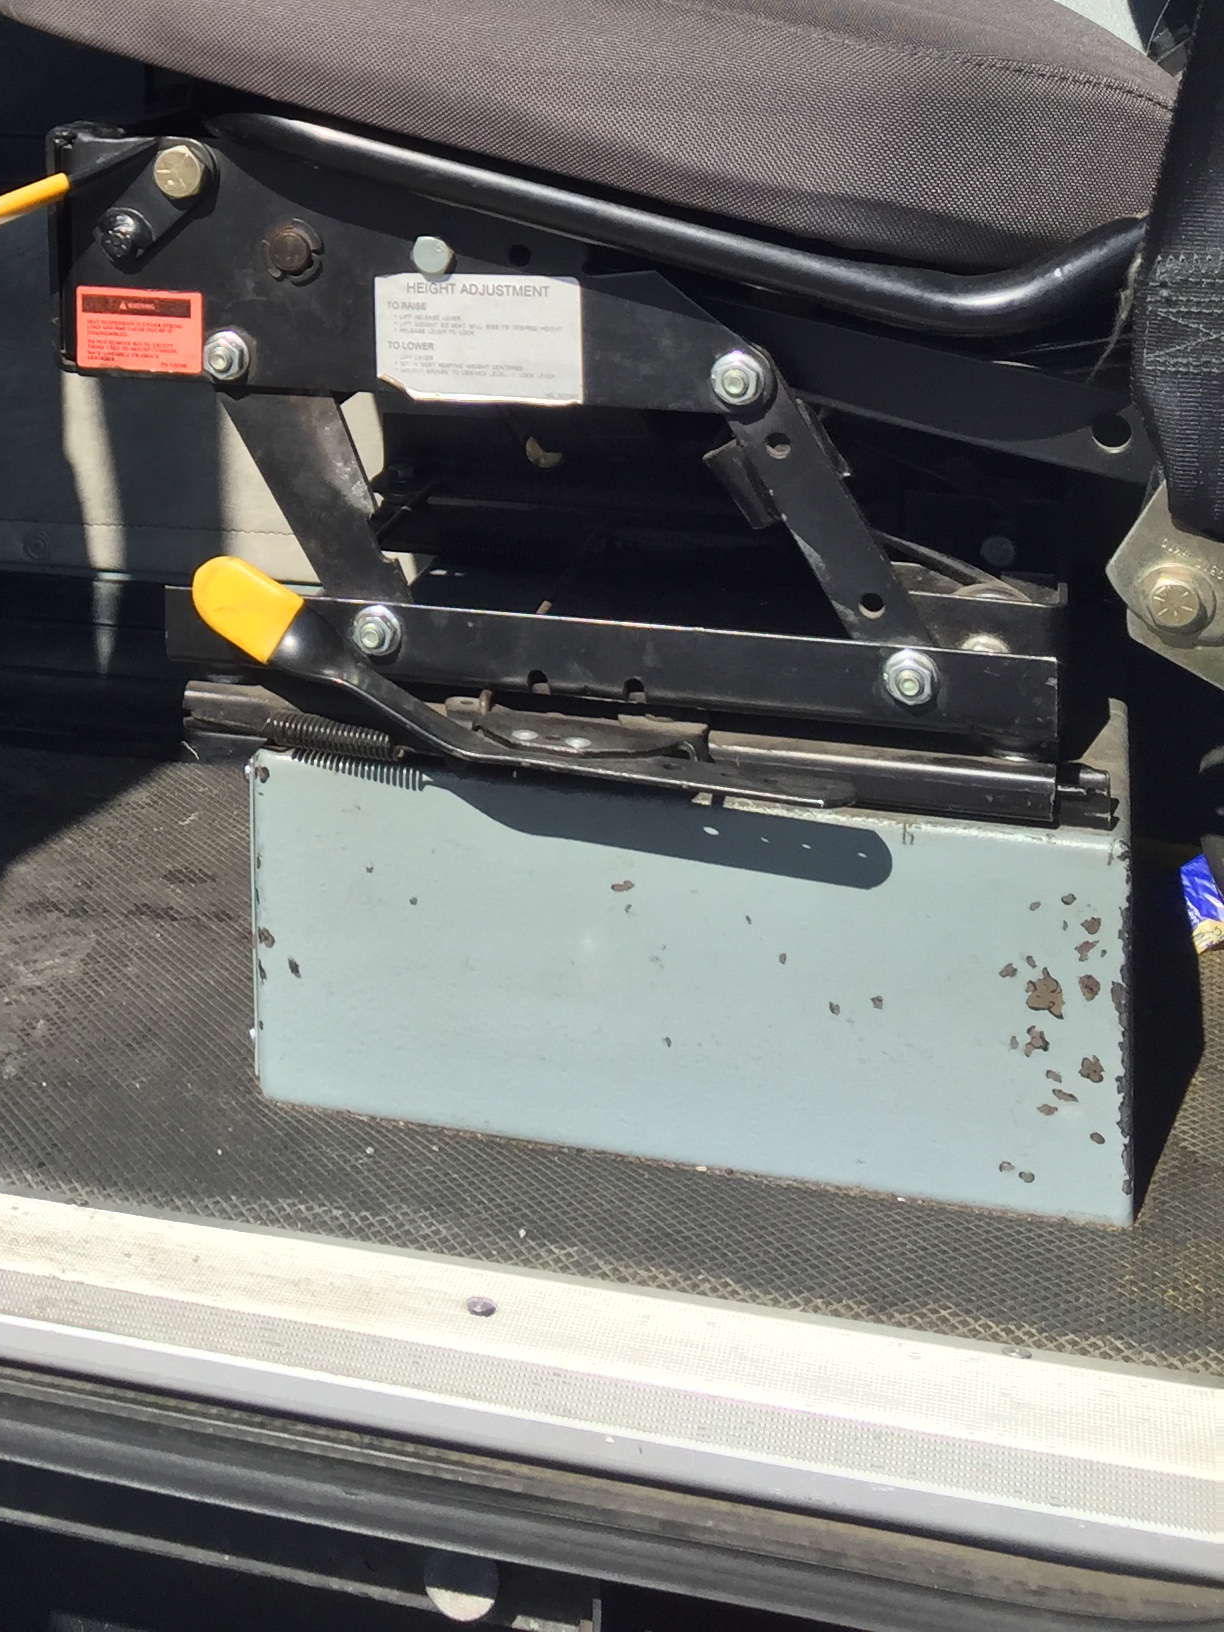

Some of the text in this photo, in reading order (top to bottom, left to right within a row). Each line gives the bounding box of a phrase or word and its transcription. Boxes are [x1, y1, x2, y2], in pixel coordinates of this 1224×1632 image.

[406, 282, 550, 298] HEIGHT ADJUSTMENT
[387, 301, 427, 311] TO RAISE
[388, 341, 434, 351] TO LOWER
